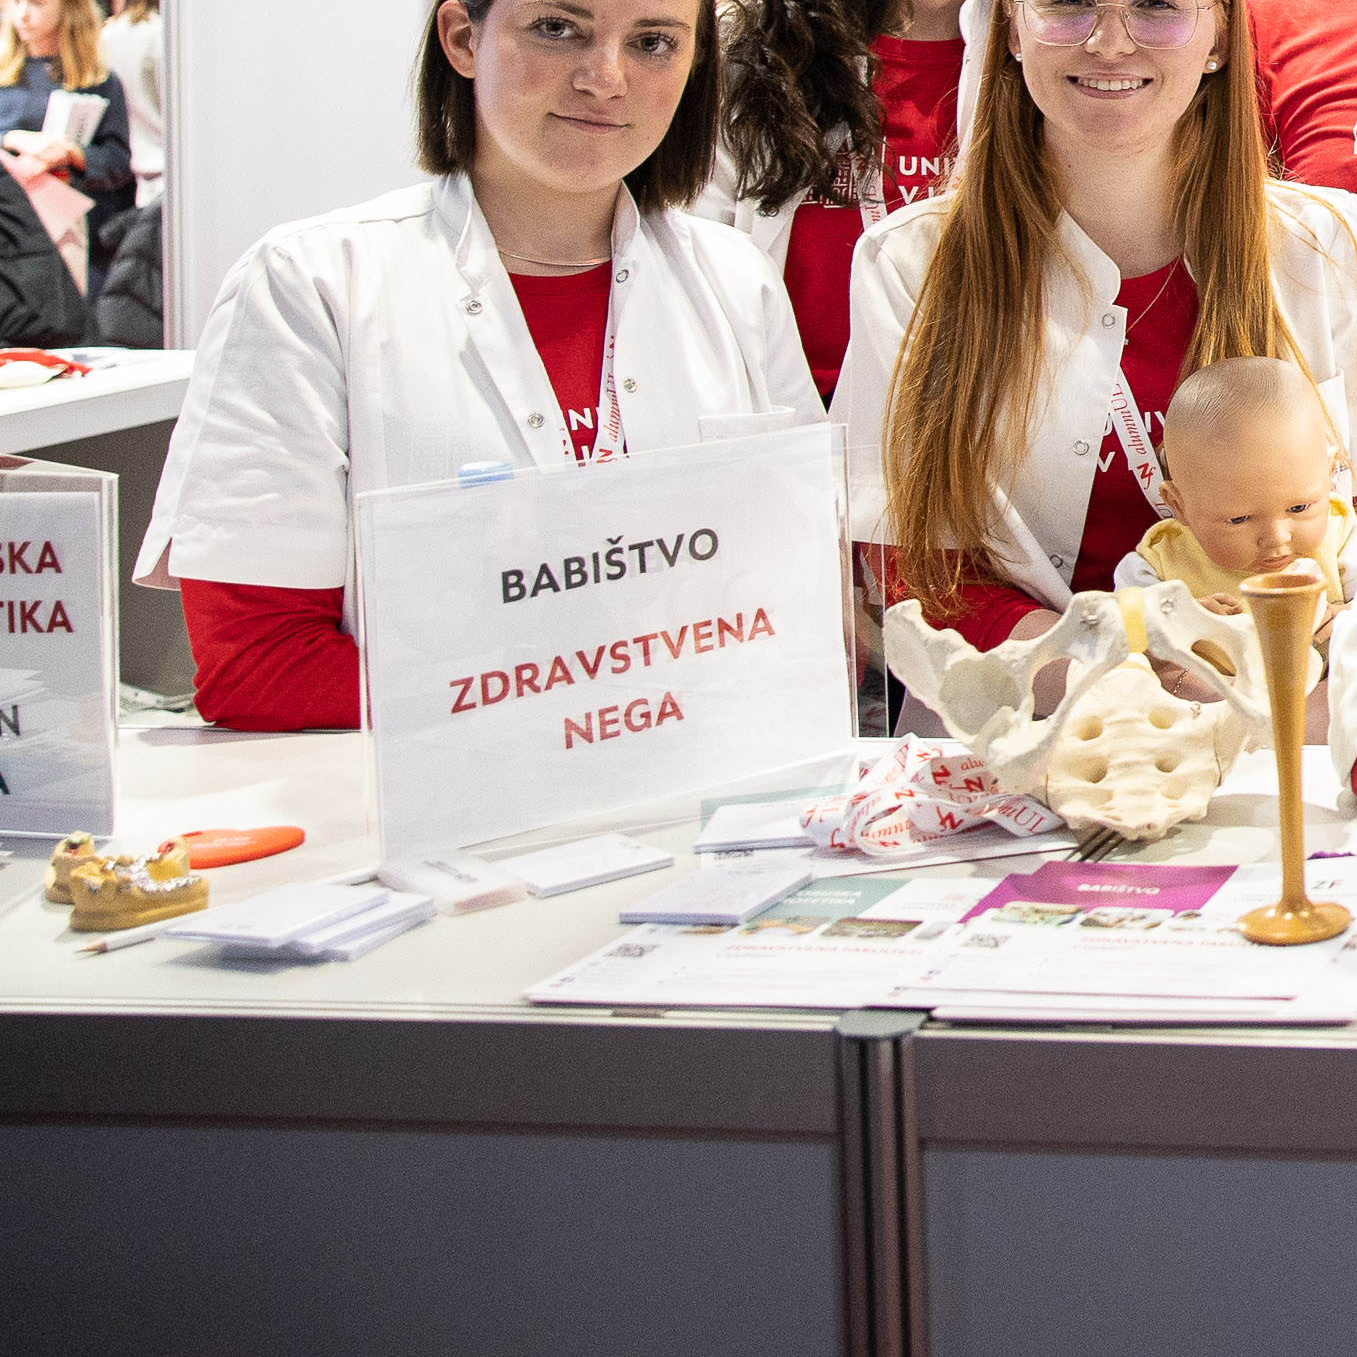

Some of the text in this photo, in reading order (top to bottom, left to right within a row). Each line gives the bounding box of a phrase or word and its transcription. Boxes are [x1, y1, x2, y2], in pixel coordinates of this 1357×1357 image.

[501, 528, 720, 604] BABIŠTVO
[449, 607, 777, 715] ZDRAVSTVENA
[564, 690, 686, 750] NEGA
